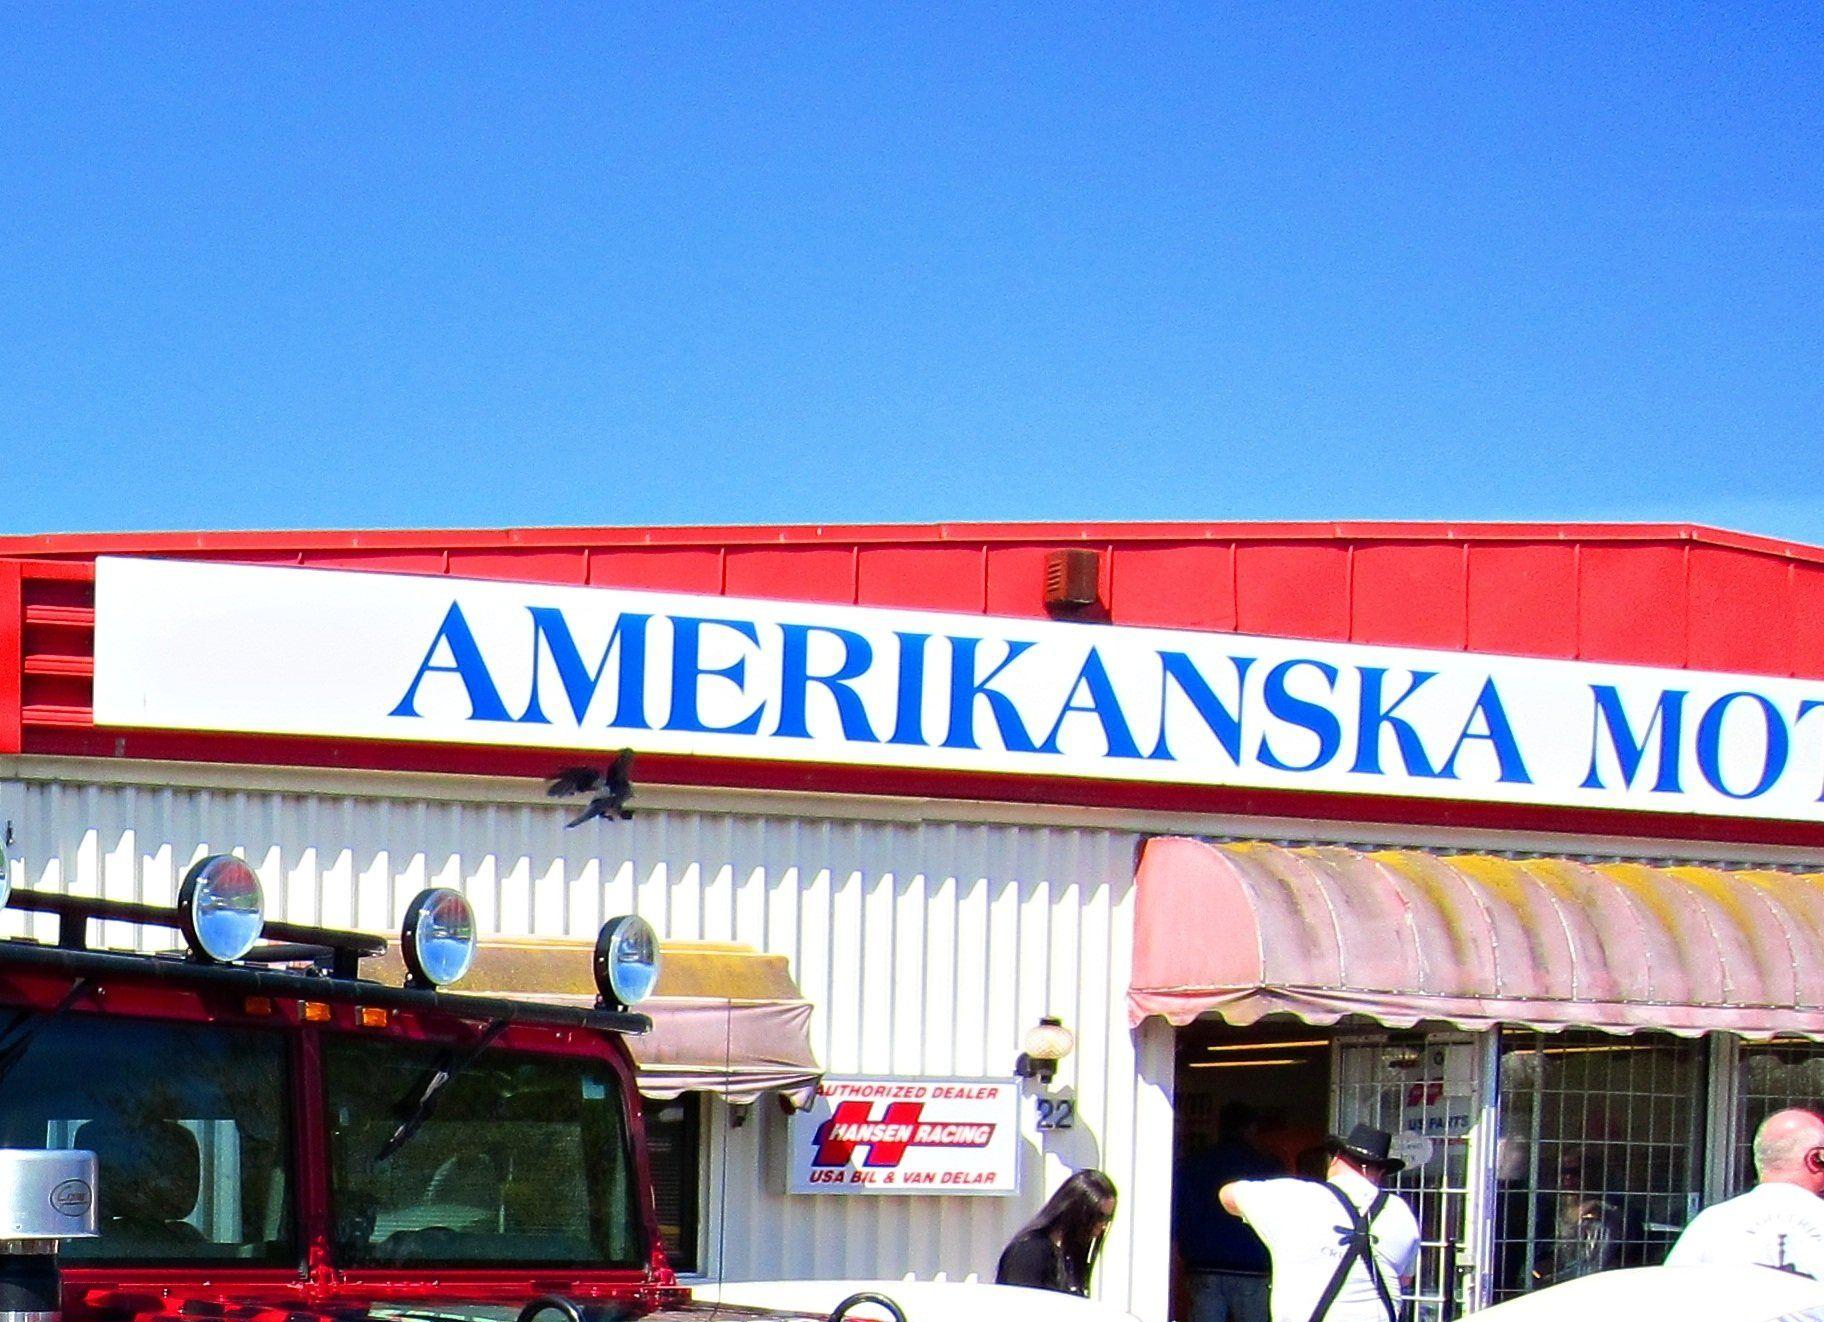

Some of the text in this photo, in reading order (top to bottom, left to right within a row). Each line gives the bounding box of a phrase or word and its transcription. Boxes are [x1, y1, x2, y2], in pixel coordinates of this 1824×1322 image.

[387, 599, 1534, 785] AMERIKANSKA
[816, 1084, 998, 1099] AUTHORIZED DEALER
[1037, 1098, 1073, 1129] 22
[829, 1123, 991, 1144] HANSEN RACING
[810, 1170, 997, 1184] USA BIL & VAN DELAR
